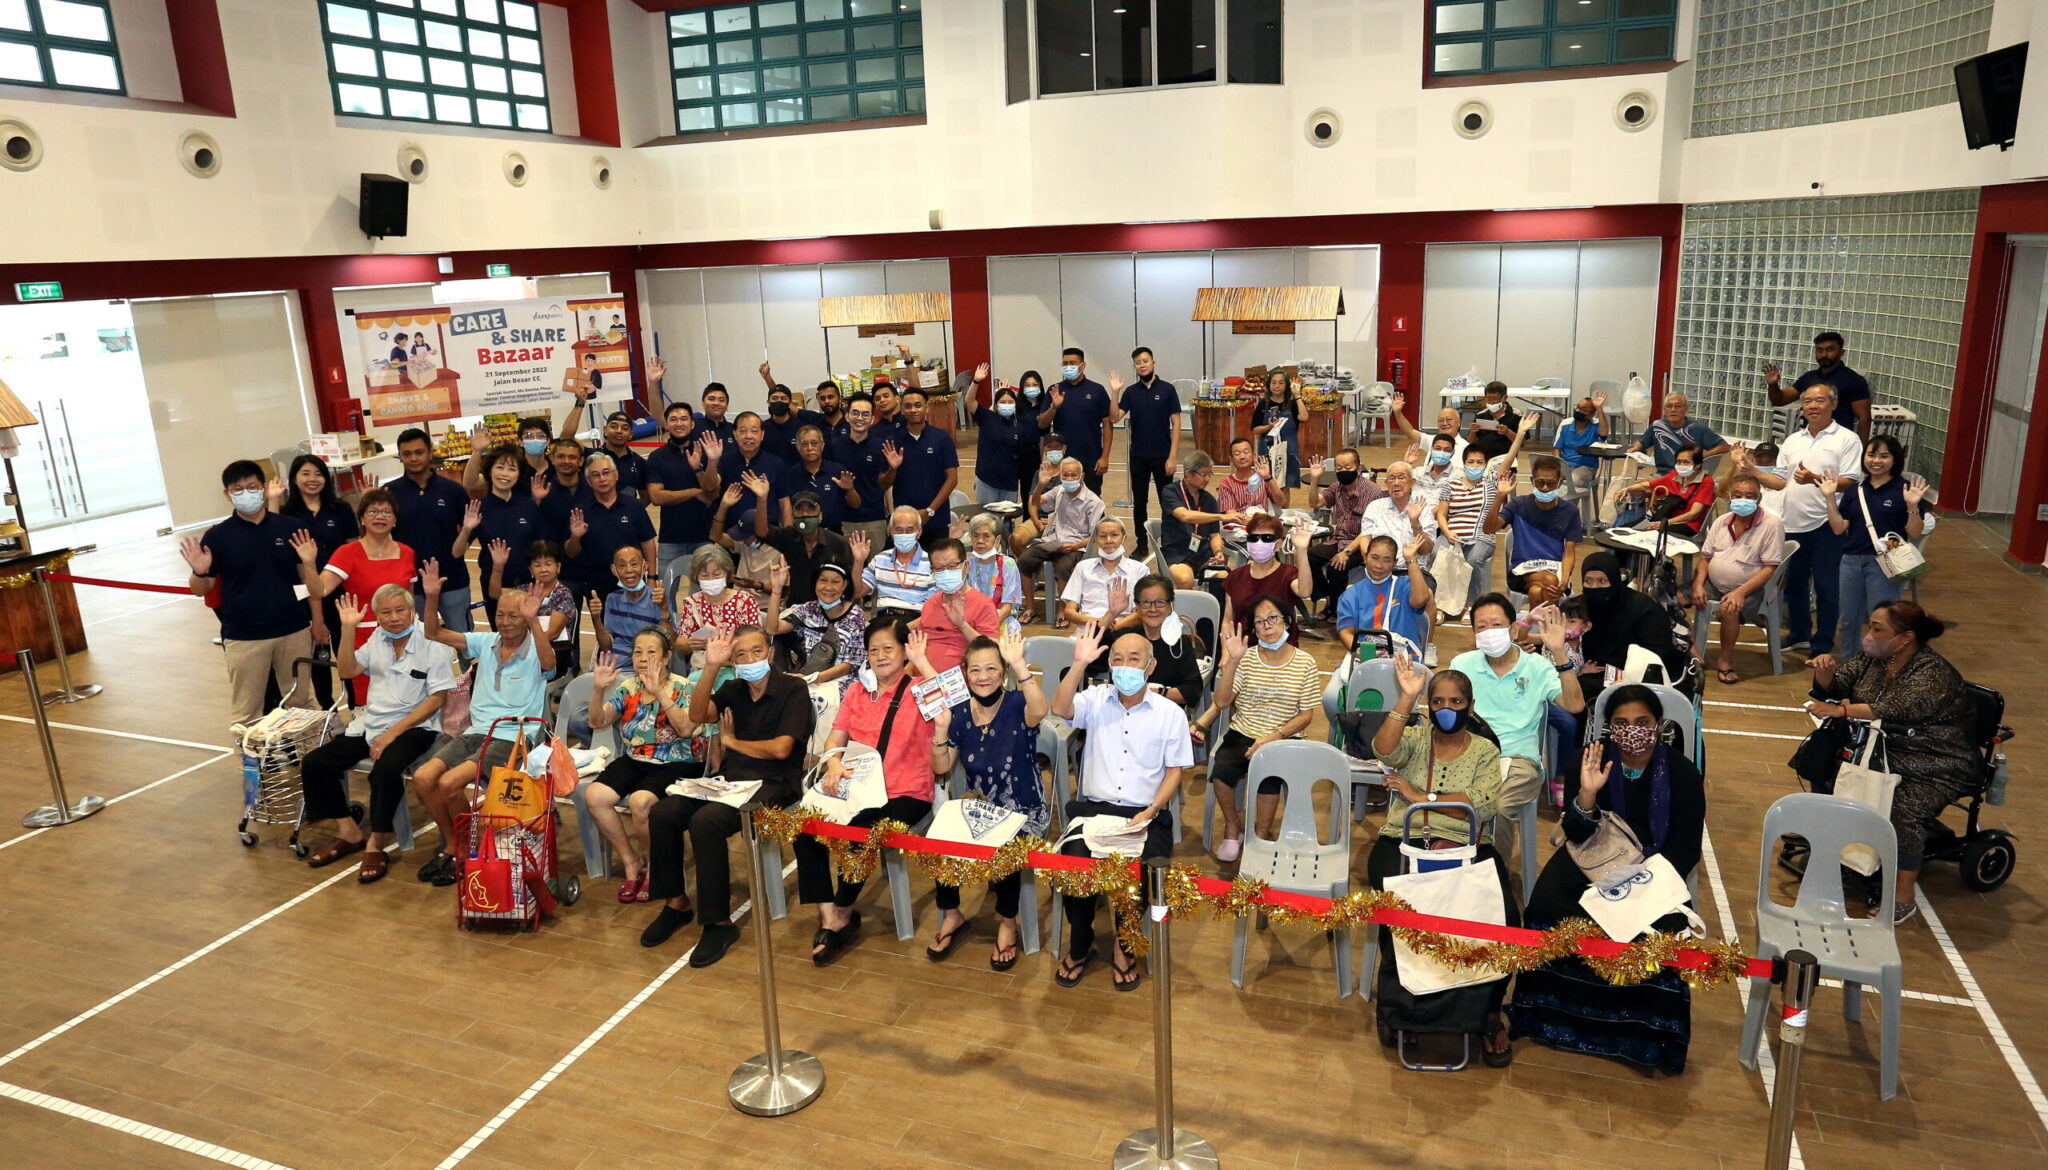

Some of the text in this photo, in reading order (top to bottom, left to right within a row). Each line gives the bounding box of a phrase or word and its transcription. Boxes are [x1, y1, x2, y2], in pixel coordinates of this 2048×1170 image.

[28, 284, 53, 298] EXIT
[452, 312, 504, 333] CARE
[491, 328, 566, 346] & SHARE
[477, 346, 555, 365] Bazaar
[597, 355, 625, 365] FRUITS
[494, 368, 531, 377] September
[493, 378, 511, 387] Jalan
[512, 376, 531, 384] Besar
[387, 394, 421, 405] SNACKS
[379, 402, 439, 416] CANNED FOOD
[974, 801, 996, 815] SHARE
